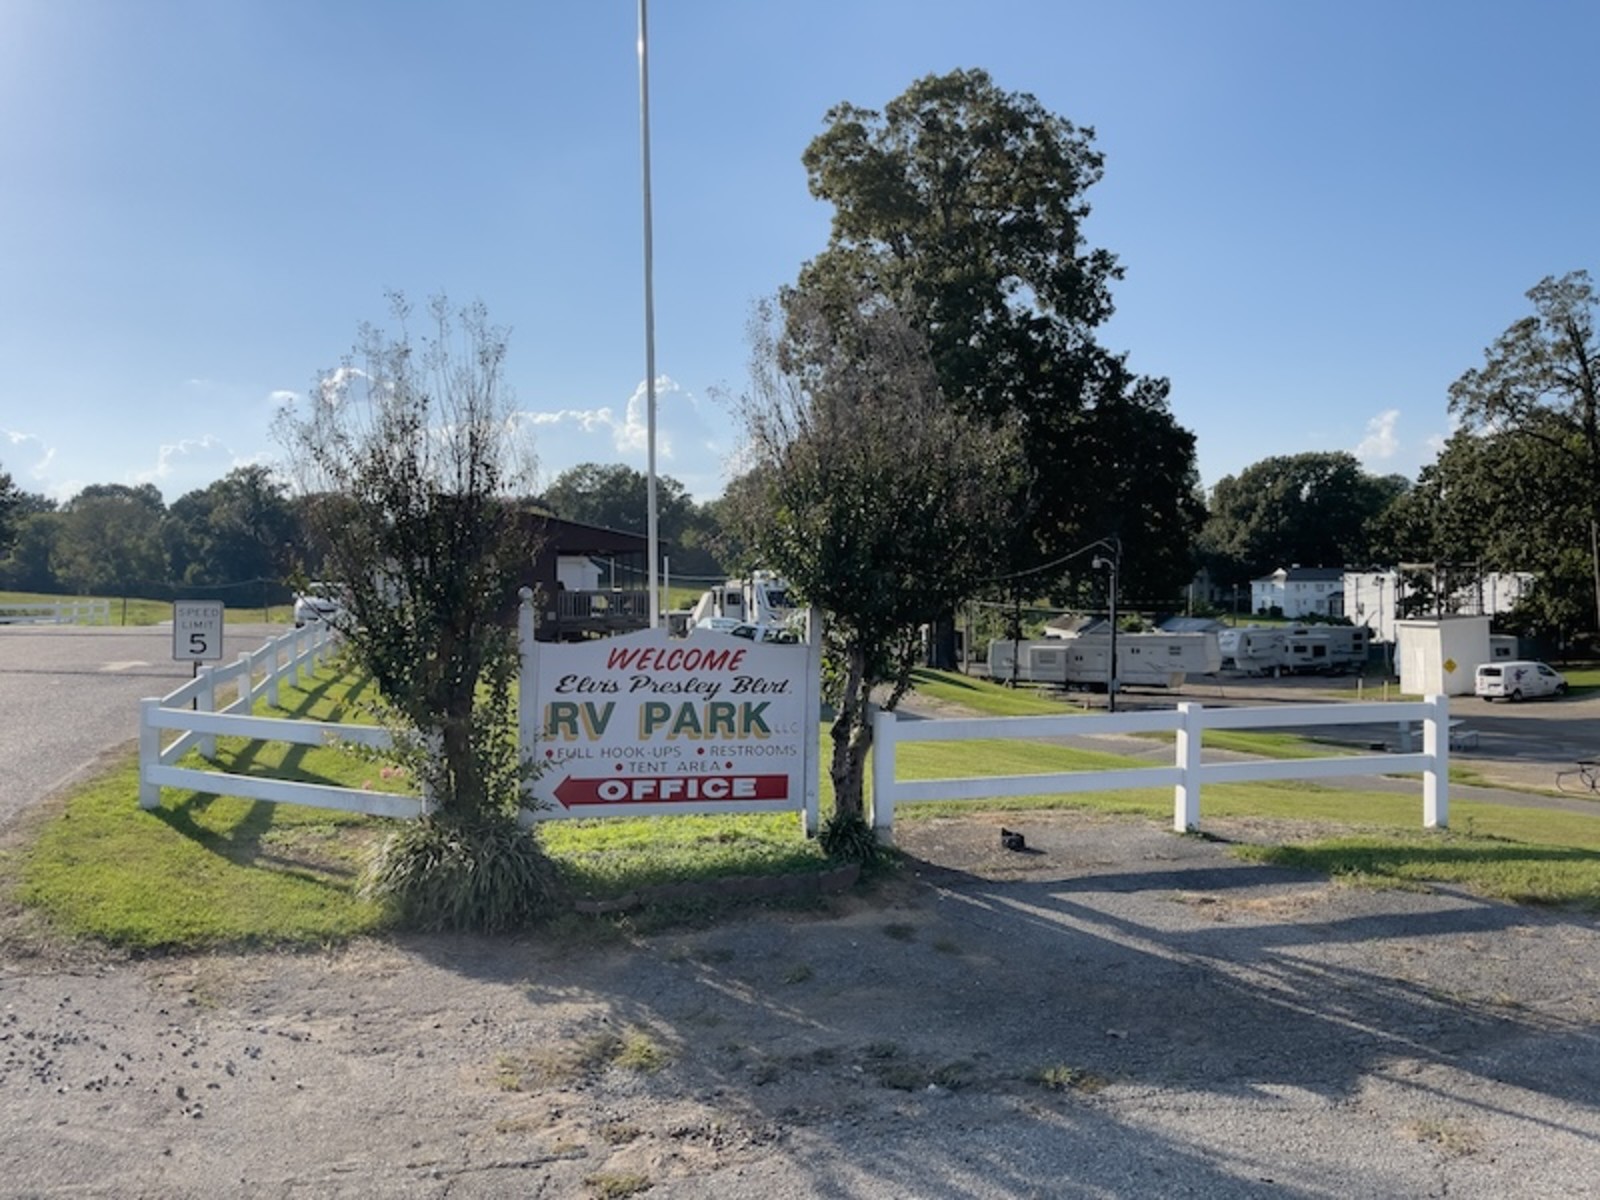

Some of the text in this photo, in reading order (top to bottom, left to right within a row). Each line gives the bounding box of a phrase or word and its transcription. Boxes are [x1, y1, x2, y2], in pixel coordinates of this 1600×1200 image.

[189, 633, 207, 654] 5
[606, 647, 747, 672] WELCOME
[555, 675, 793, 701] Elvis Presley Blvd.
[543, 701, 800, 741] RV PARK LLC
[557, 744, 797, 759] FULL HOOK-UPS RESTROOMS
[629, 760, 721, 773] TENT AREA
[597, 777, 757, 801] OFFICE
